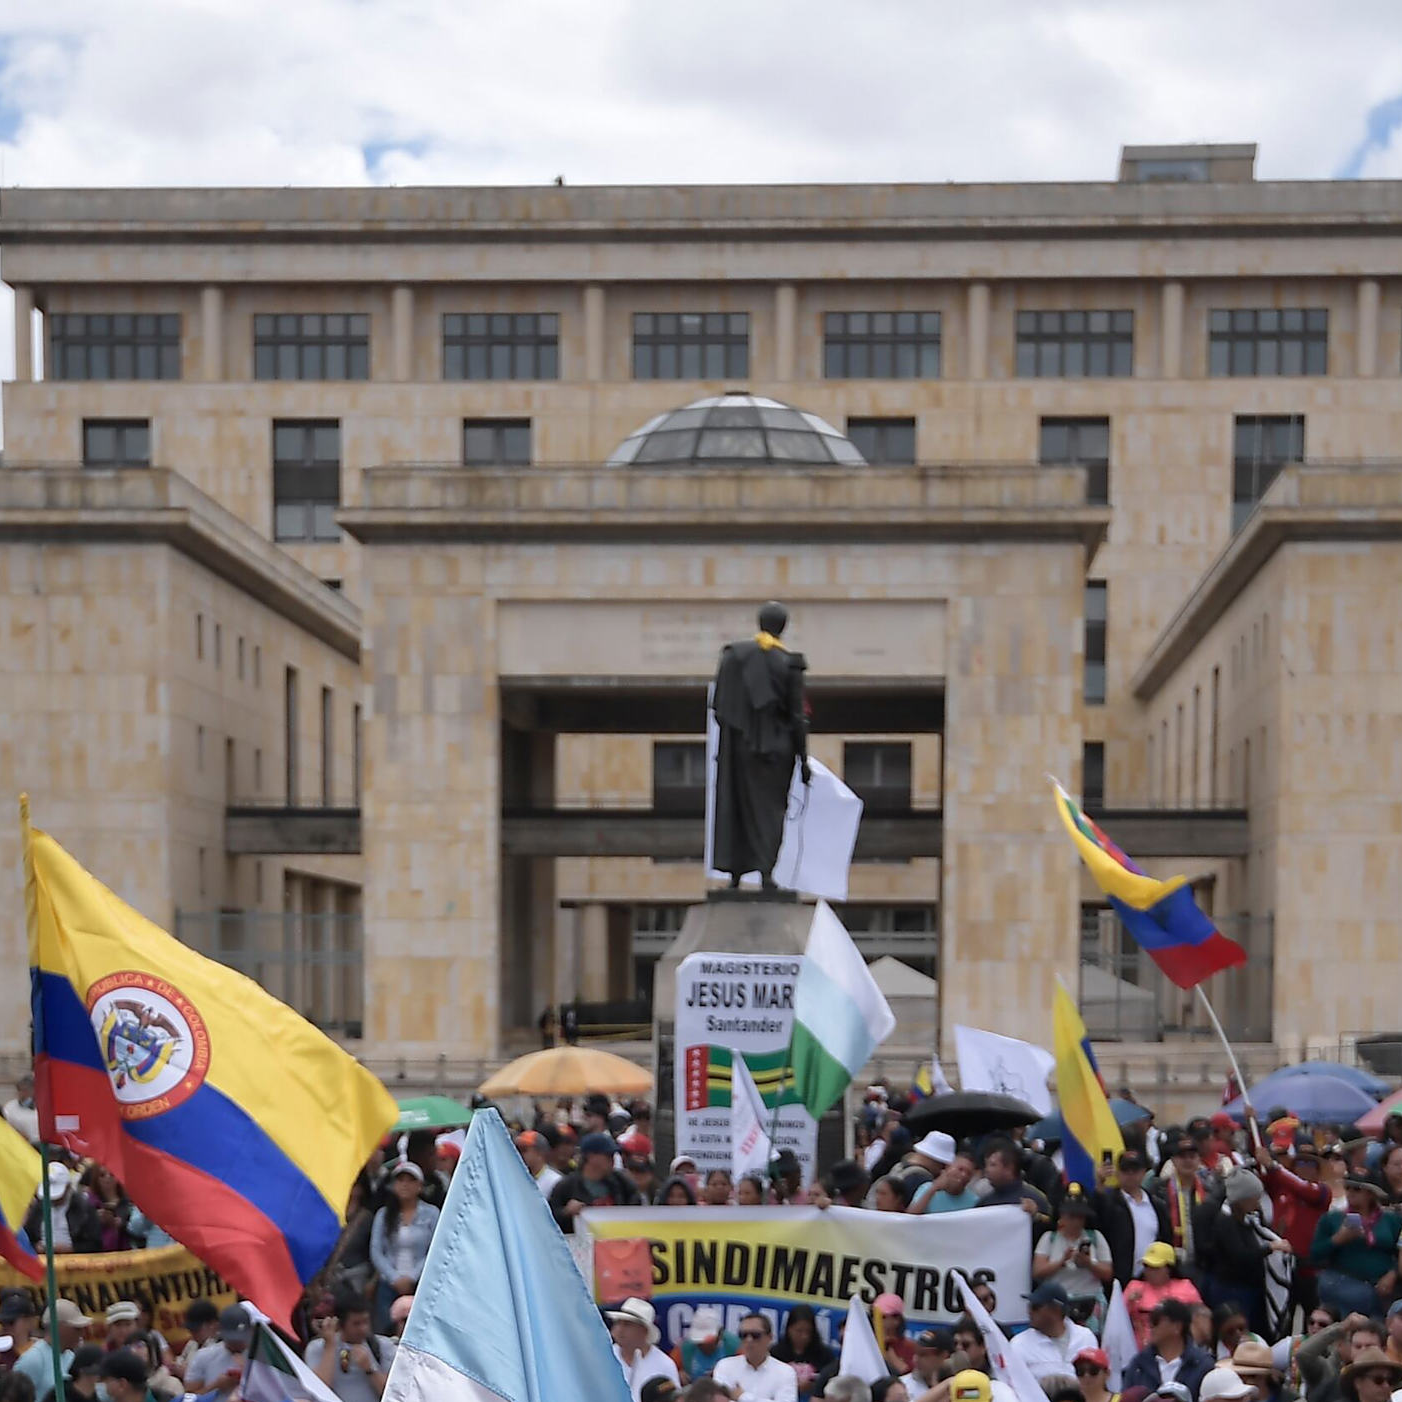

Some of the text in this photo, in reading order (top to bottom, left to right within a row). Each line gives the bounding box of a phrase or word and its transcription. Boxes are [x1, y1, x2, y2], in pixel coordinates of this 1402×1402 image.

[701, 963, 799, 976] MAGISTERIO
[687, 982, 794, 1008] JESUS MAR
